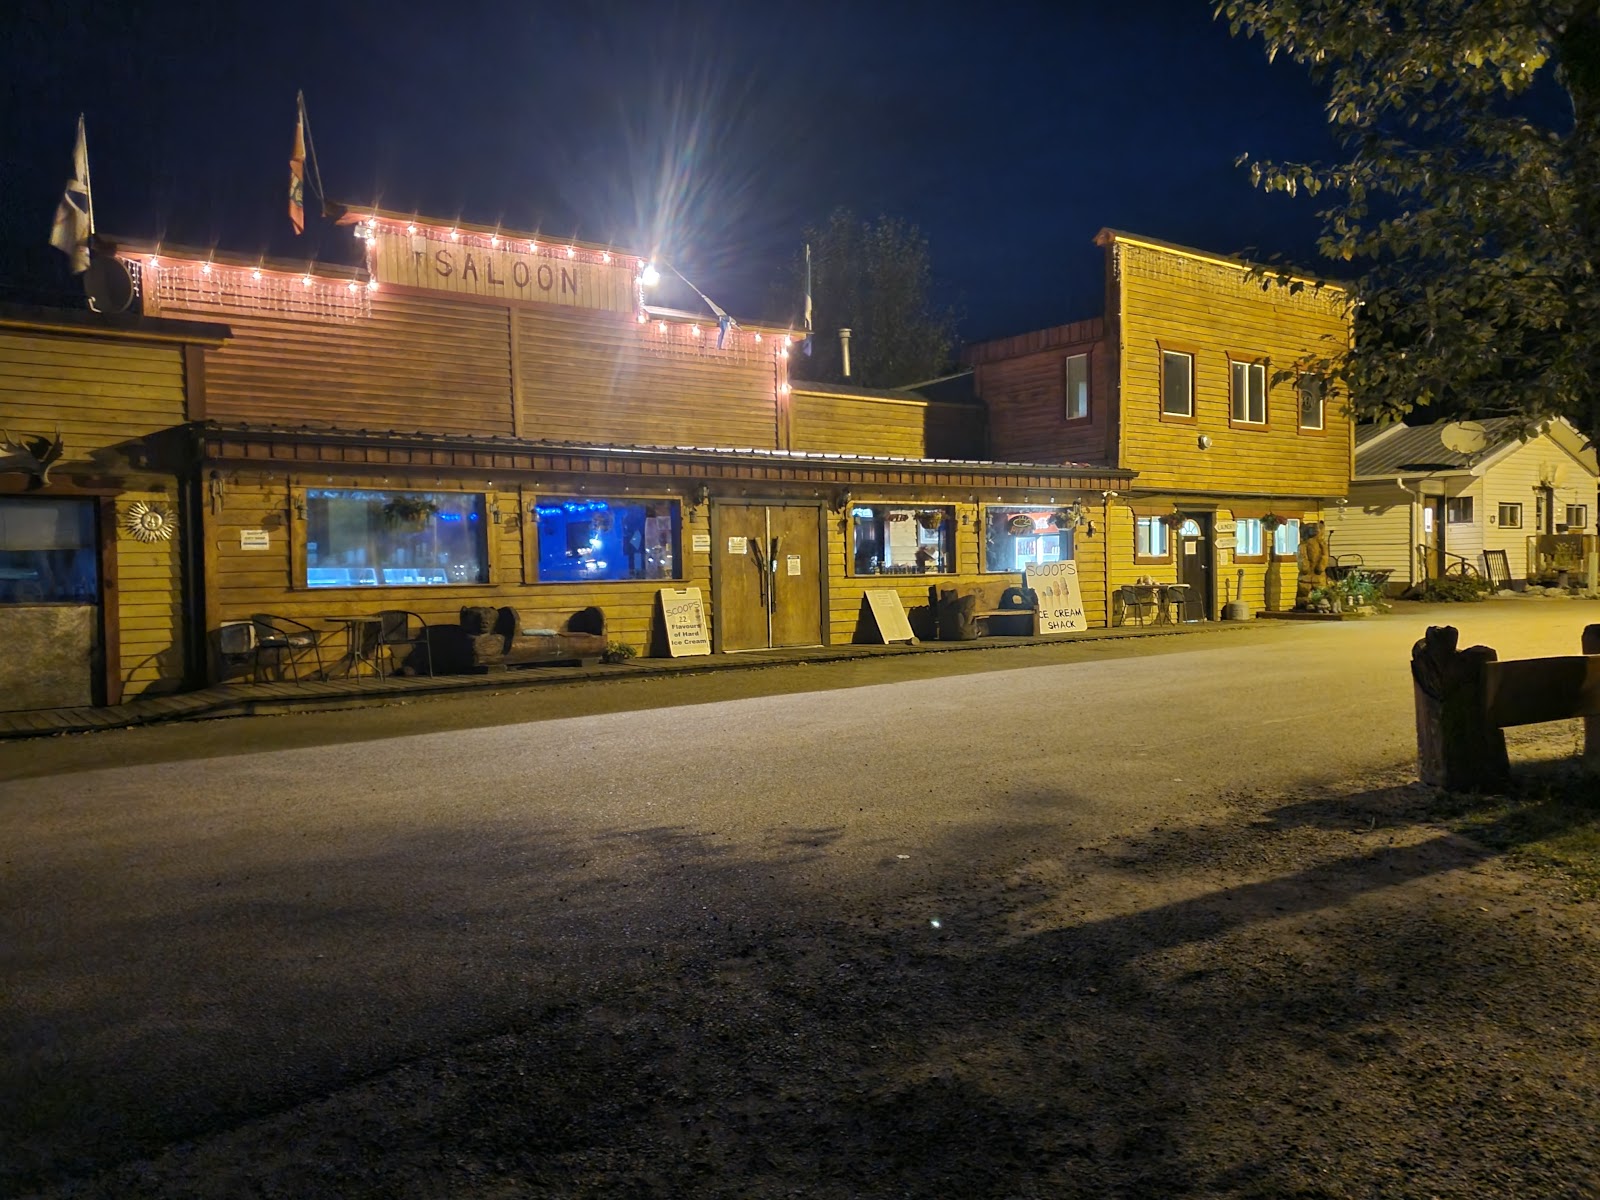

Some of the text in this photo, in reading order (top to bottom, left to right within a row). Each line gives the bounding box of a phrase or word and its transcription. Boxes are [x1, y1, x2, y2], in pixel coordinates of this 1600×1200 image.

[435, 250, 578, 295] SALOON
[1027, 563, 1076, 577] SCOOPS
[666, 601, 700, 617] SCOOPS
[1039, 608, 1082, 619] CE CREAM
[1048, 620, 1076, 629] SHACK
